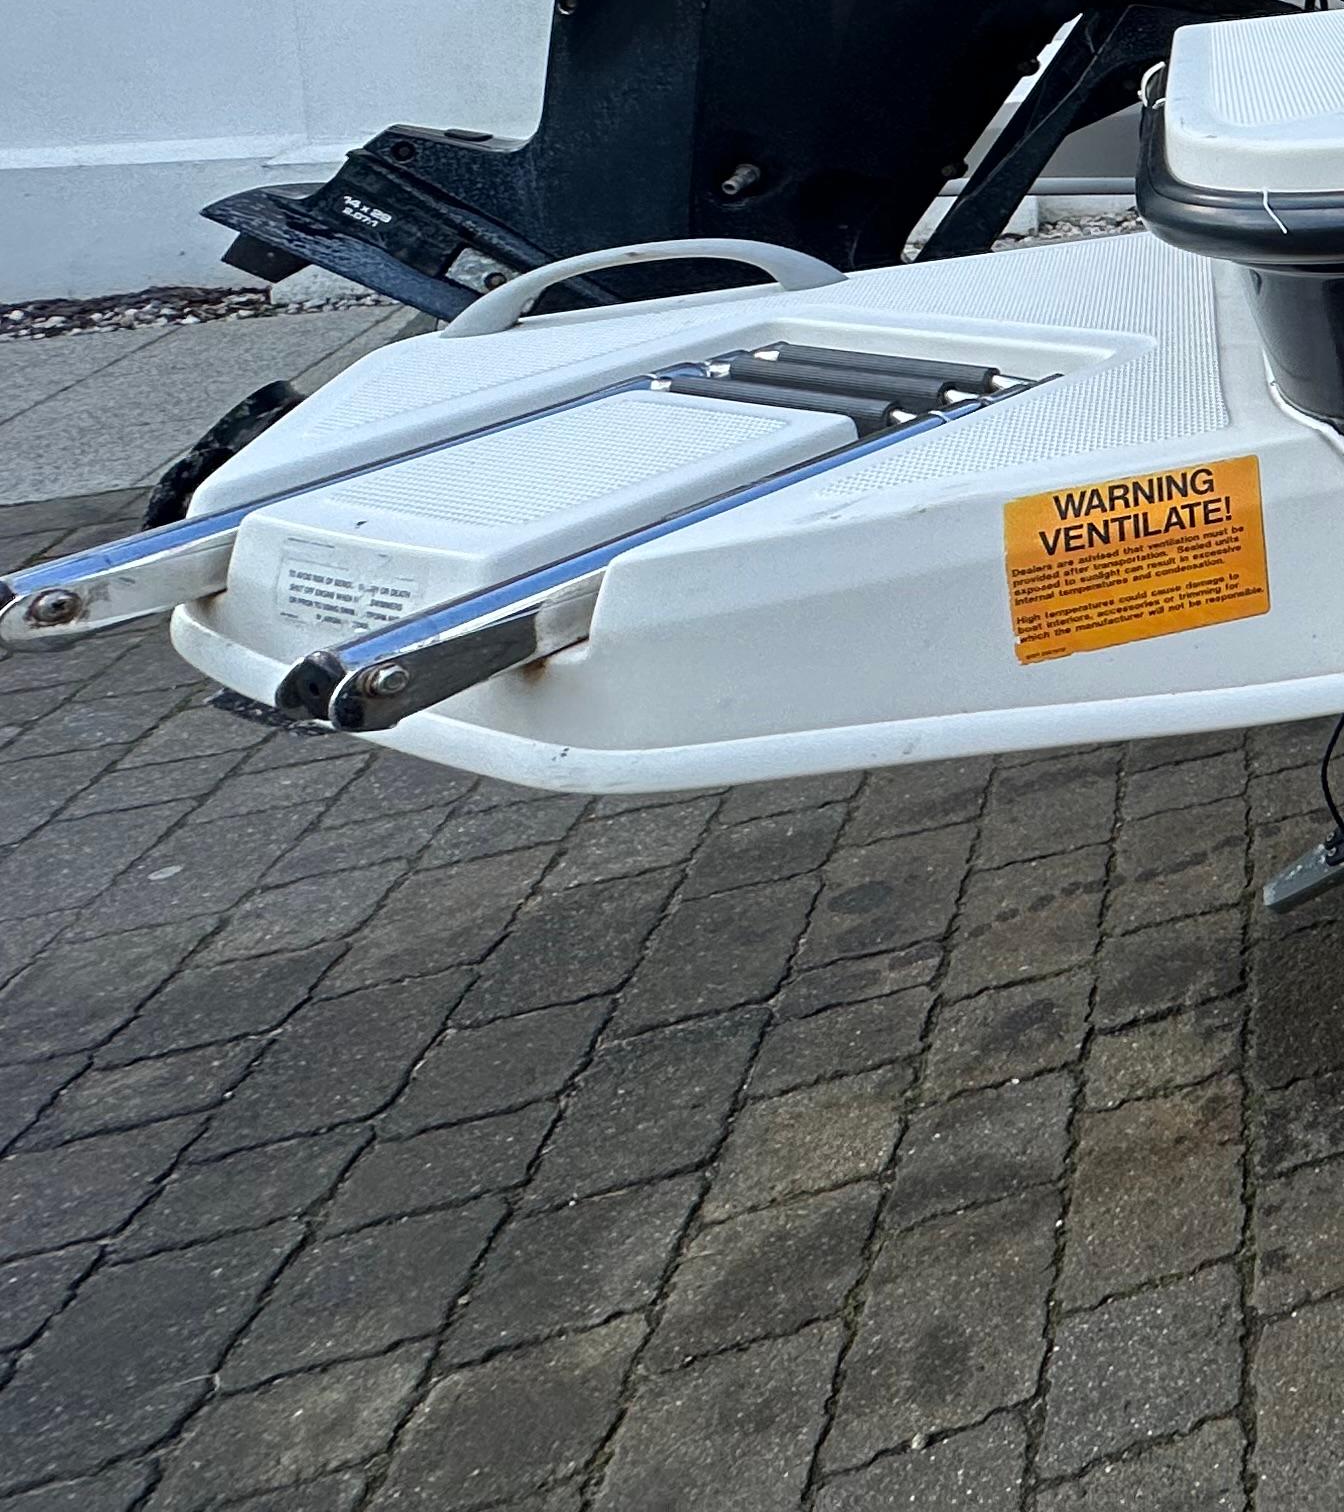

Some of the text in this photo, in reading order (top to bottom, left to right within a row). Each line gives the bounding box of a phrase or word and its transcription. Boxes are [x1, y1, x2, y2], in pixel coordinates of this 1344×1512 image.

[1053, 468, 1214, 520] WARNING
[1039, 496, 1231, 555] VENTILATE!
[1057, 560, 1074, 568] are
[1123, 545, 1143, 554] that
[1148, 535, 1200, 550] ventilation
[1203, 529, 1228, 539] must
[1231, 526, 1244, 535] be
[1013, 571, 1060, 588] provided
[1064, 565, 1089, 577] after
[1014, 545, 1241, 596] exposed to sunlight can result in excessive
[1058, 577, 1128, 596] temperatures
[1132, 571, 1152, 582] and
[1016, 573, 1240, 624] High temperatures could cause damage to
[1017, 623, 1042, 634] boat
[1097, 598, 1160, 617] accessories
[1179, 586, 1221, 601] trimming
[1054, 627, 1071, 636] the
[1075, 610, 1144, 632] manufacturer
[1168, 602, 1184, 612] not
[1189, 600, 1201, 608] be
